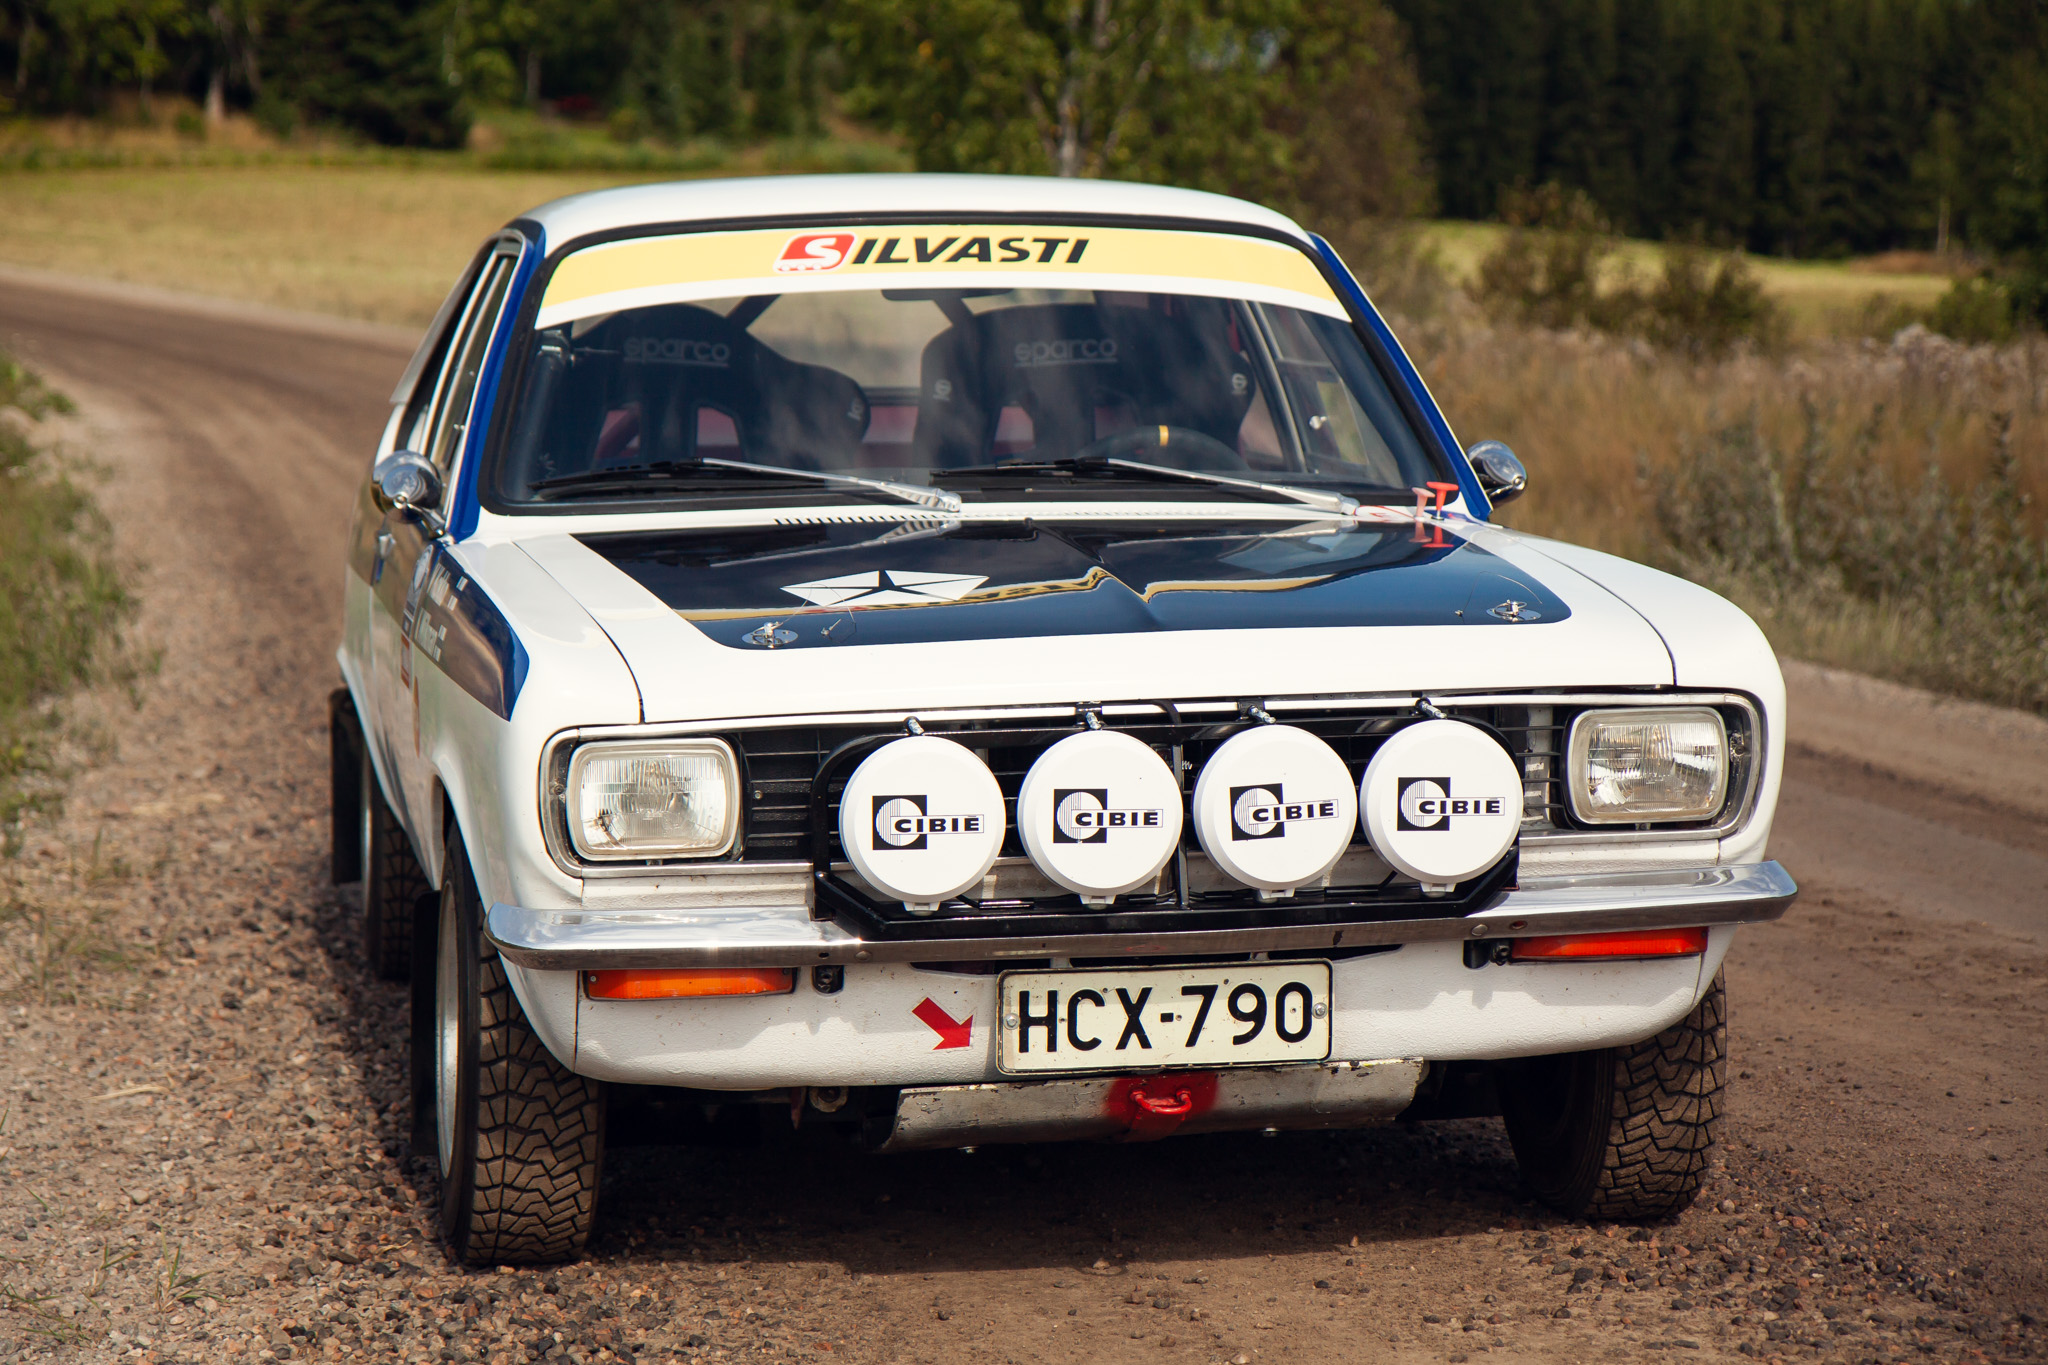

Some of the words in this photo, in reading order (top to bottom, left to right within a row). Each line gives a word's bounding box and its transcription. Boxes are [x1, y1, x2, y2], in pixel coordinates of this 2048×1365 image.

[780, 234, 1090, 270] SILVASTI
[623, 337, 730, 365] sparco
[1014, 339, 1118, 366] sparco
[1018, 981, 1312, 1053] HCX-790
